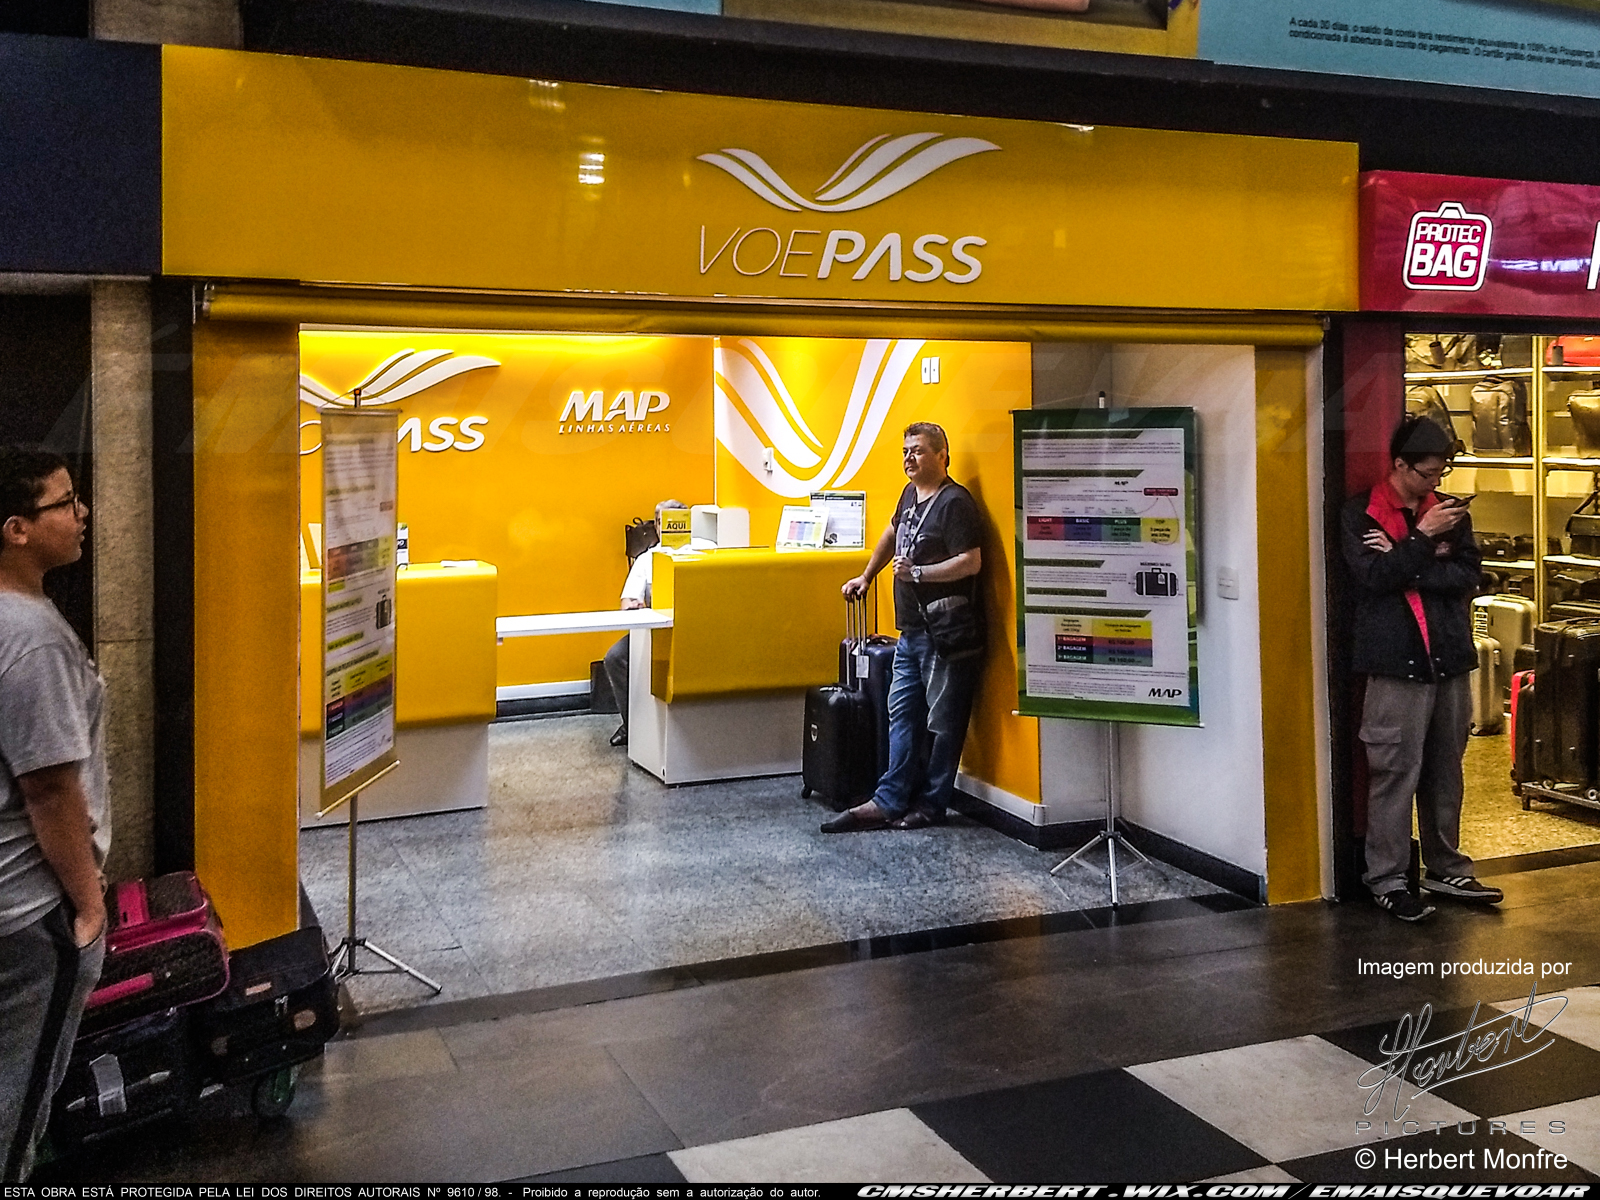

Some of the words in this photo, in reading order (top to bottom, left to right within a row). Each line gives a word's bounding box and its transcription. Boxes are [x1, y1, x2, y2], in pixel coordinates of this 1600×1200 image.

[1298, 18, 1318, 28] cada
[1414, 223, 1482, 243] PROTEC
[699, 224, 988, 284] VOEPASS
[1409, 243, 1480, 279] BAG
[559, 390, 671, 422] MAP
[558, 424, 615, 435] LINHAS
[618, 421, 671, 434] AÉREAS
[666, 522, 687, 530] AQUI
[1148, 687, 1183, 699] MAP
